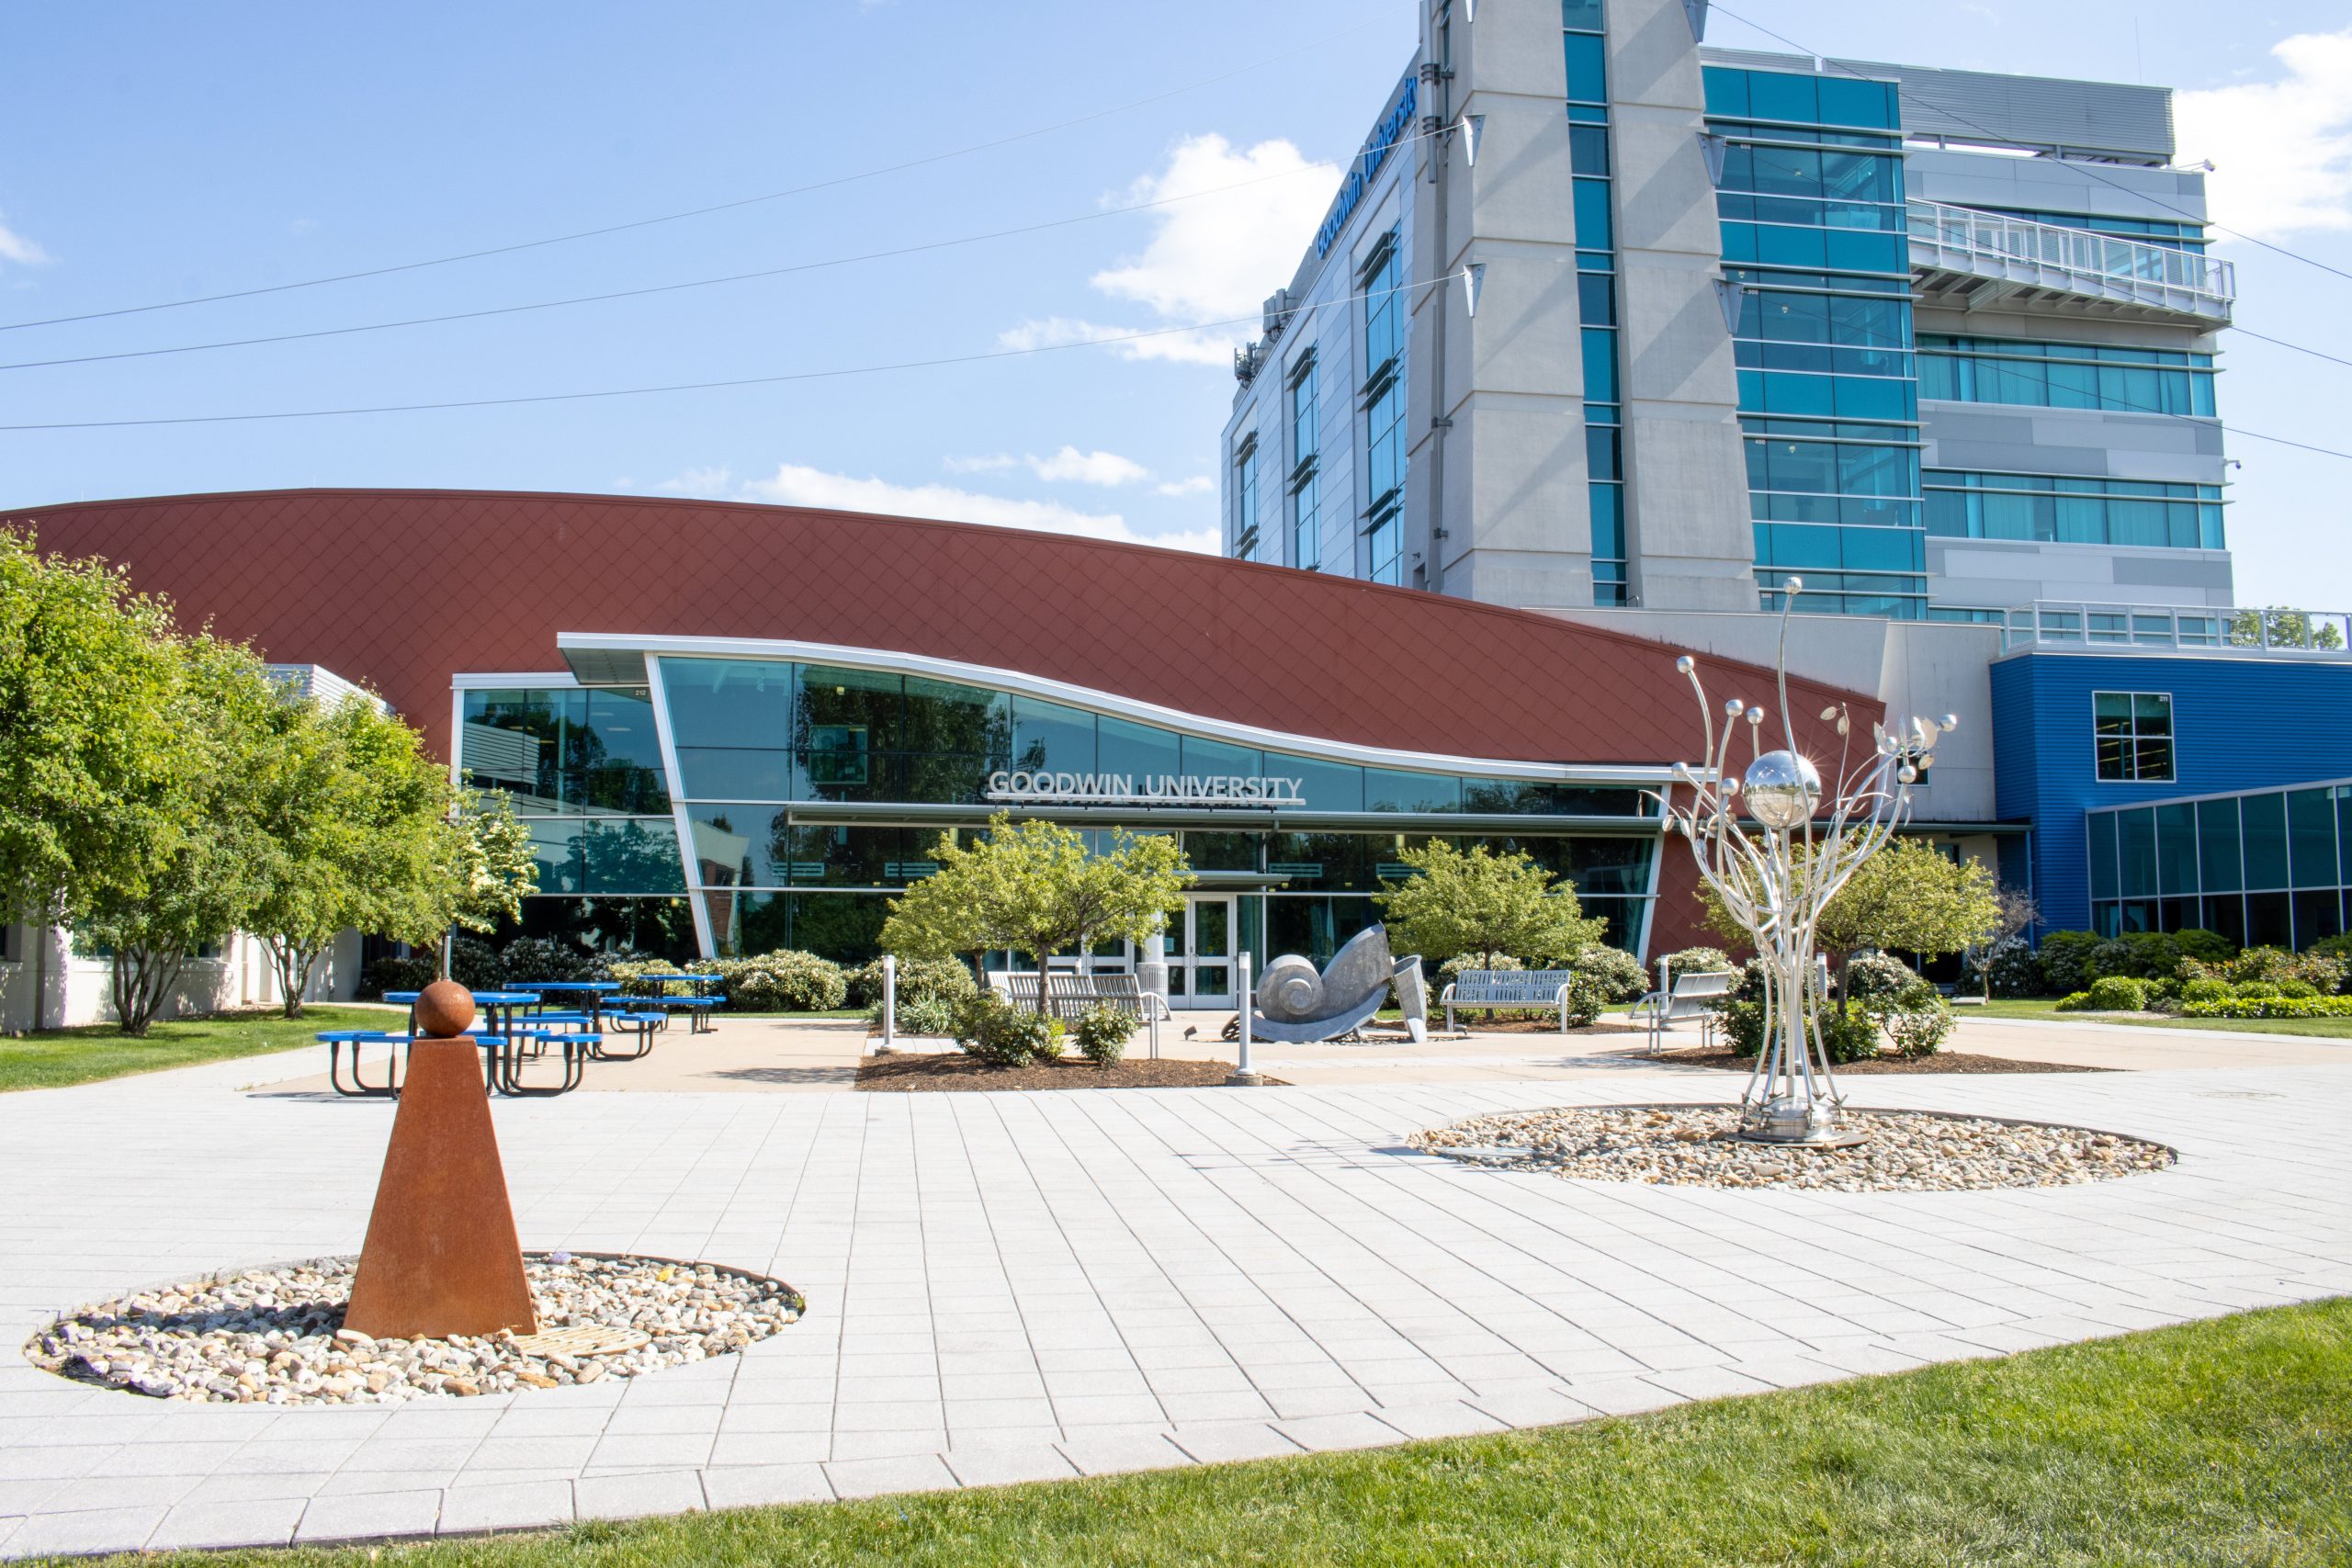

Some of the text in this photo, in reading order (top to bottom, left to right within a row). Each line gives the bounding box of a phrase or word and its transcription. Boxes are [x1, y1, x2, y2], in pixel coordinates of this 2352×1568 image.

[1317, 76, 1419, 260] Goodwin University
[988, 771, 1303, 799] GOODWIN UNIVERSITY
